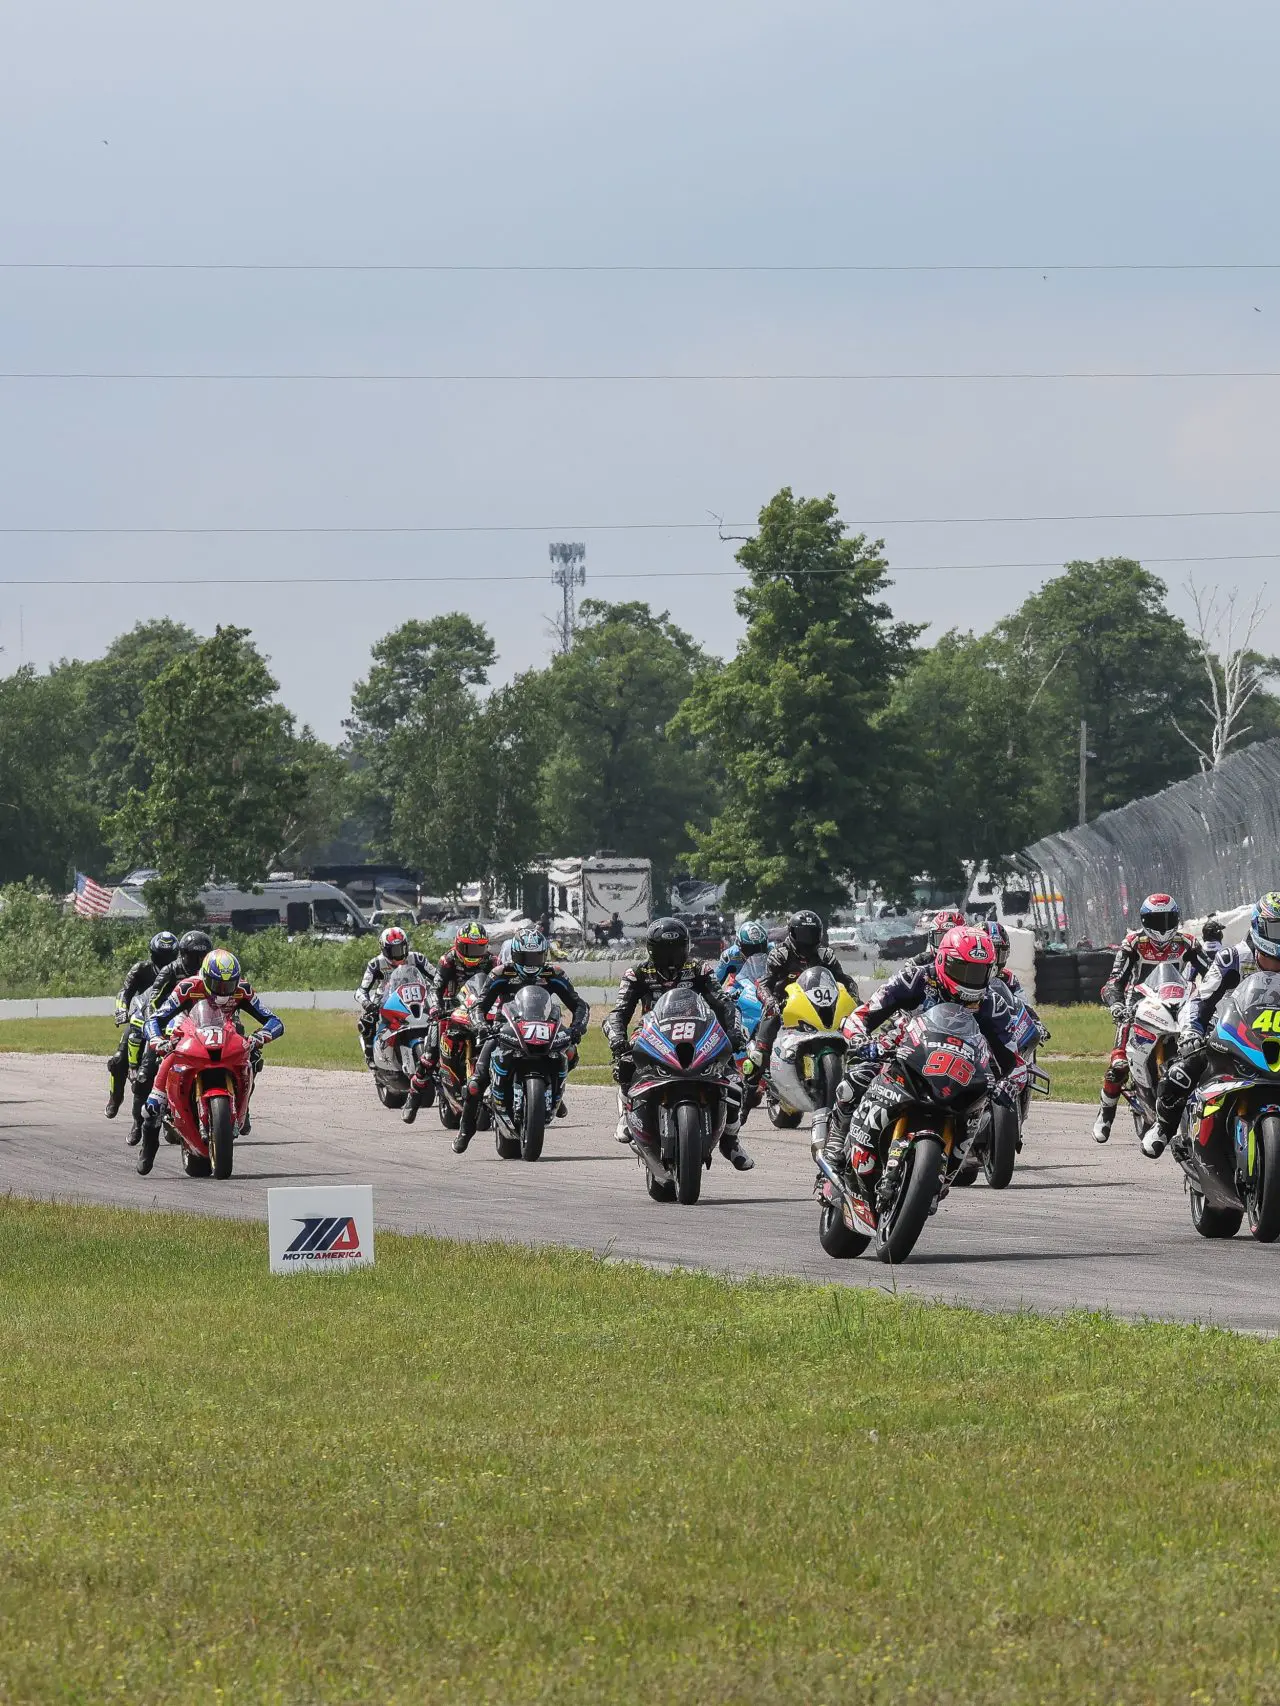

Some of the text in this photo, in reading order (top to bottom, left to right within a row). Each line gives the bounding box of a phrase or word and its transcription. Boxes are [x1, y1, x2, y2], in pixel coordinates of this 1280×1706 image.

[814, 989, 833, 1003] 94
[522, 1024, 550, 1040] 78
[671, 1022, 696, 1040] 28
[927, 1041, 976, 1062] SUZUKI
[922, 1051, 976, 1087] 96
[282, 1250, 362, 1261] MOTOAMERICA
